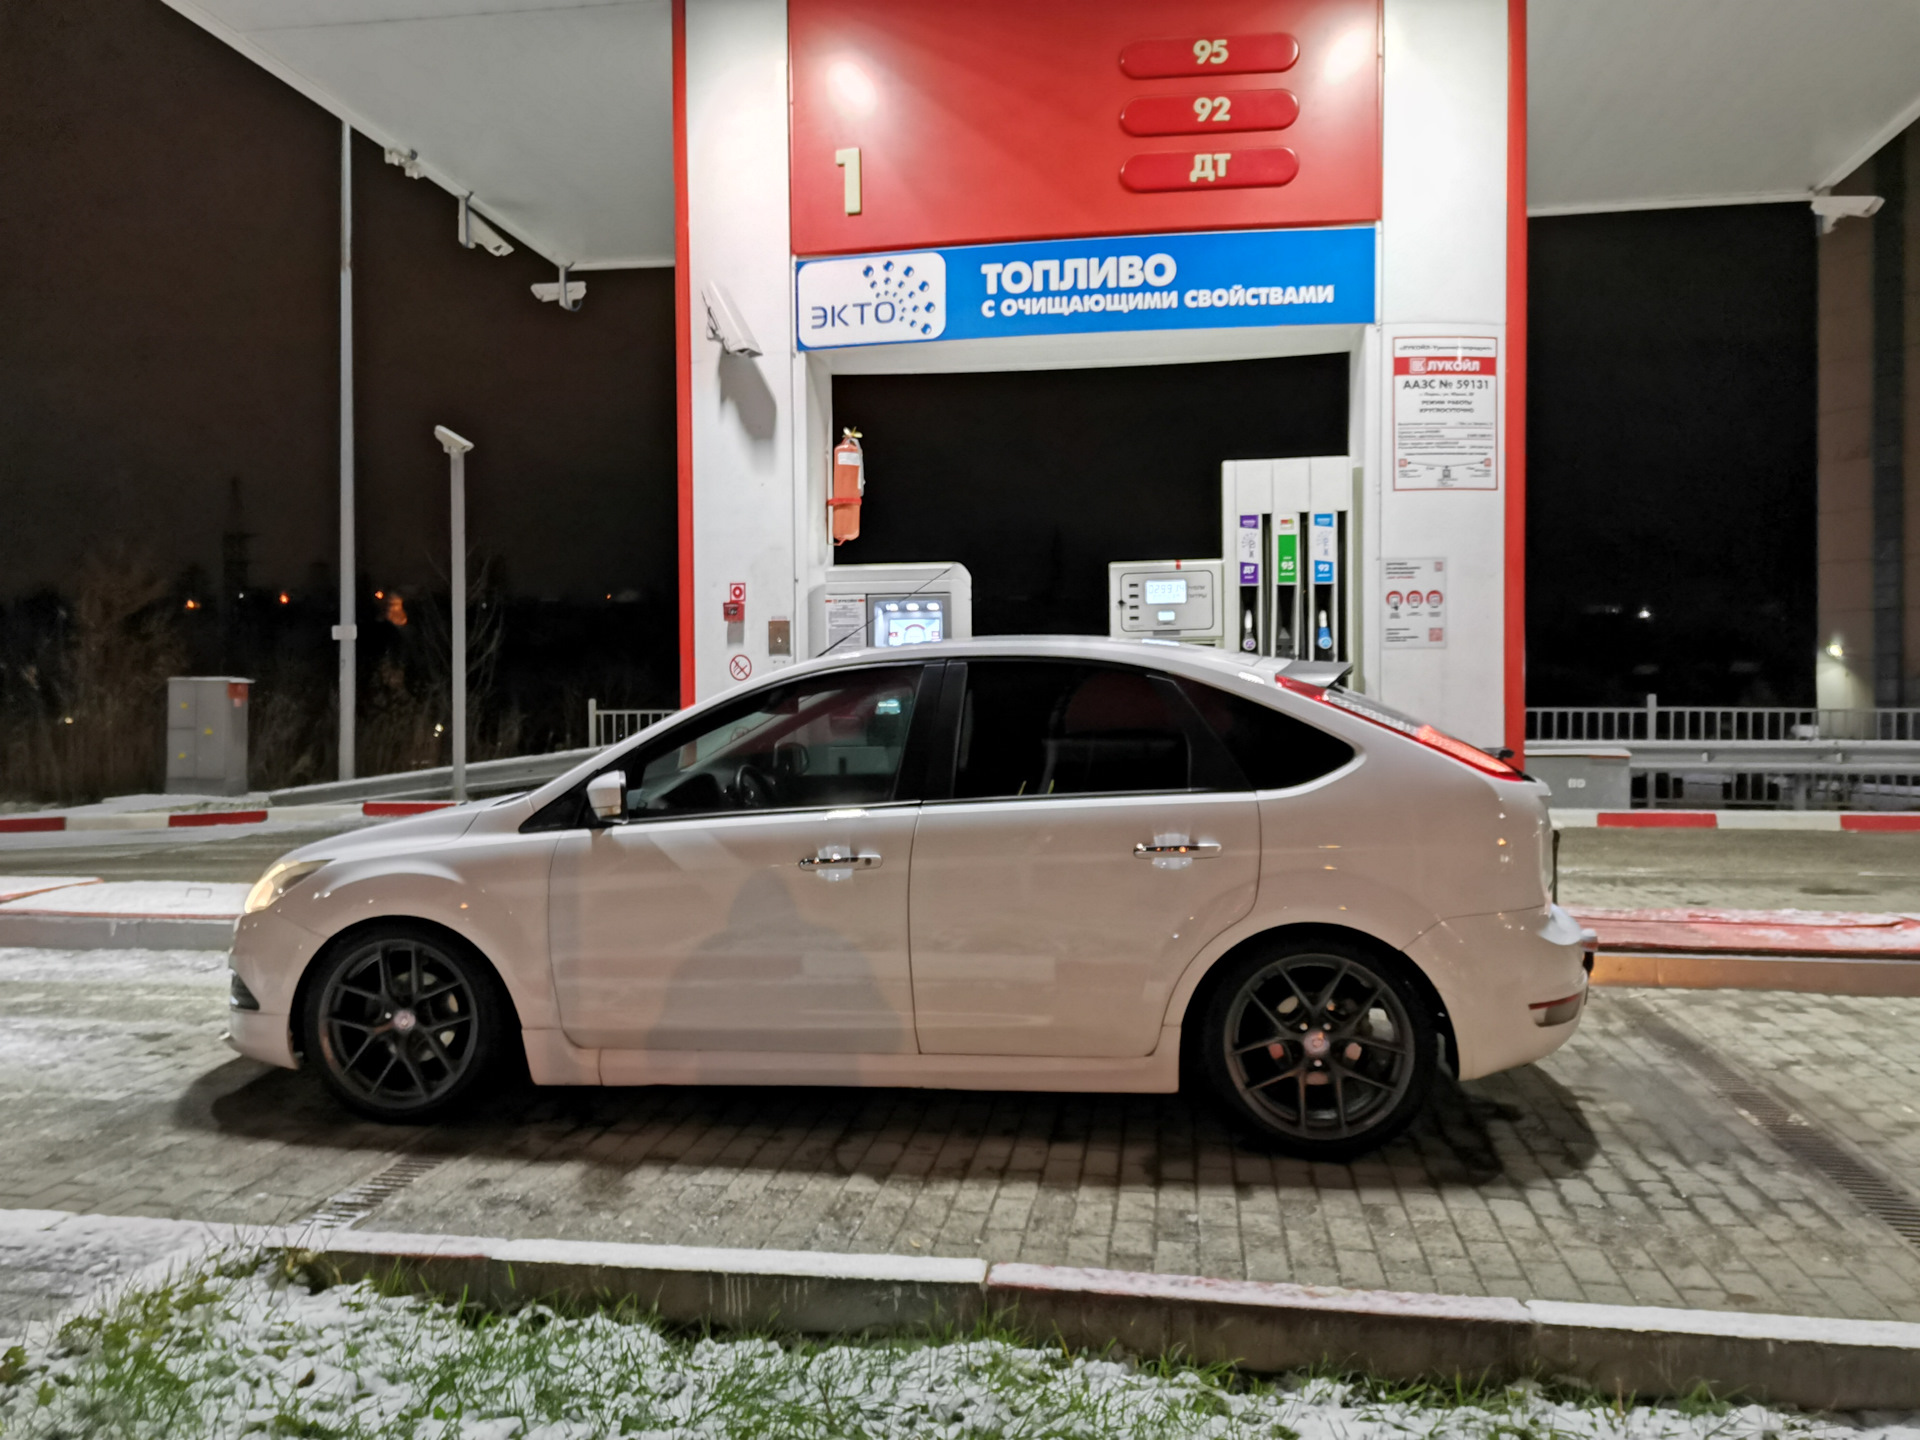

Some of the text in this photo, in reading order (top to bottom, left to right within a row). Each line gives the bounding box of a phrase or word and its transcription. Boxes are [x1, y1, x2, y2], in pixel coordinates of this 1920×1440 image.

[1193, 40, 1229, 65] 95
[1193, 97, 1231, 122] 92
[834, 147, 863, 217] 1
[1190, 153, 1231, 183] ДТ
[981, 253, 1178, 295] ТОПЛИВО
[810, 300, 897, 329] ЭКТО
[981, 284, 1335, 318] С ОЧИЩАЮЩИМИ СВОЙСТВАМИ
[1427, 358, 1481, 372] ЛУКОЙЛ
[1403, 379, 1436, 390] ААЗС
[1456, 379, 1489, 390] 59131
